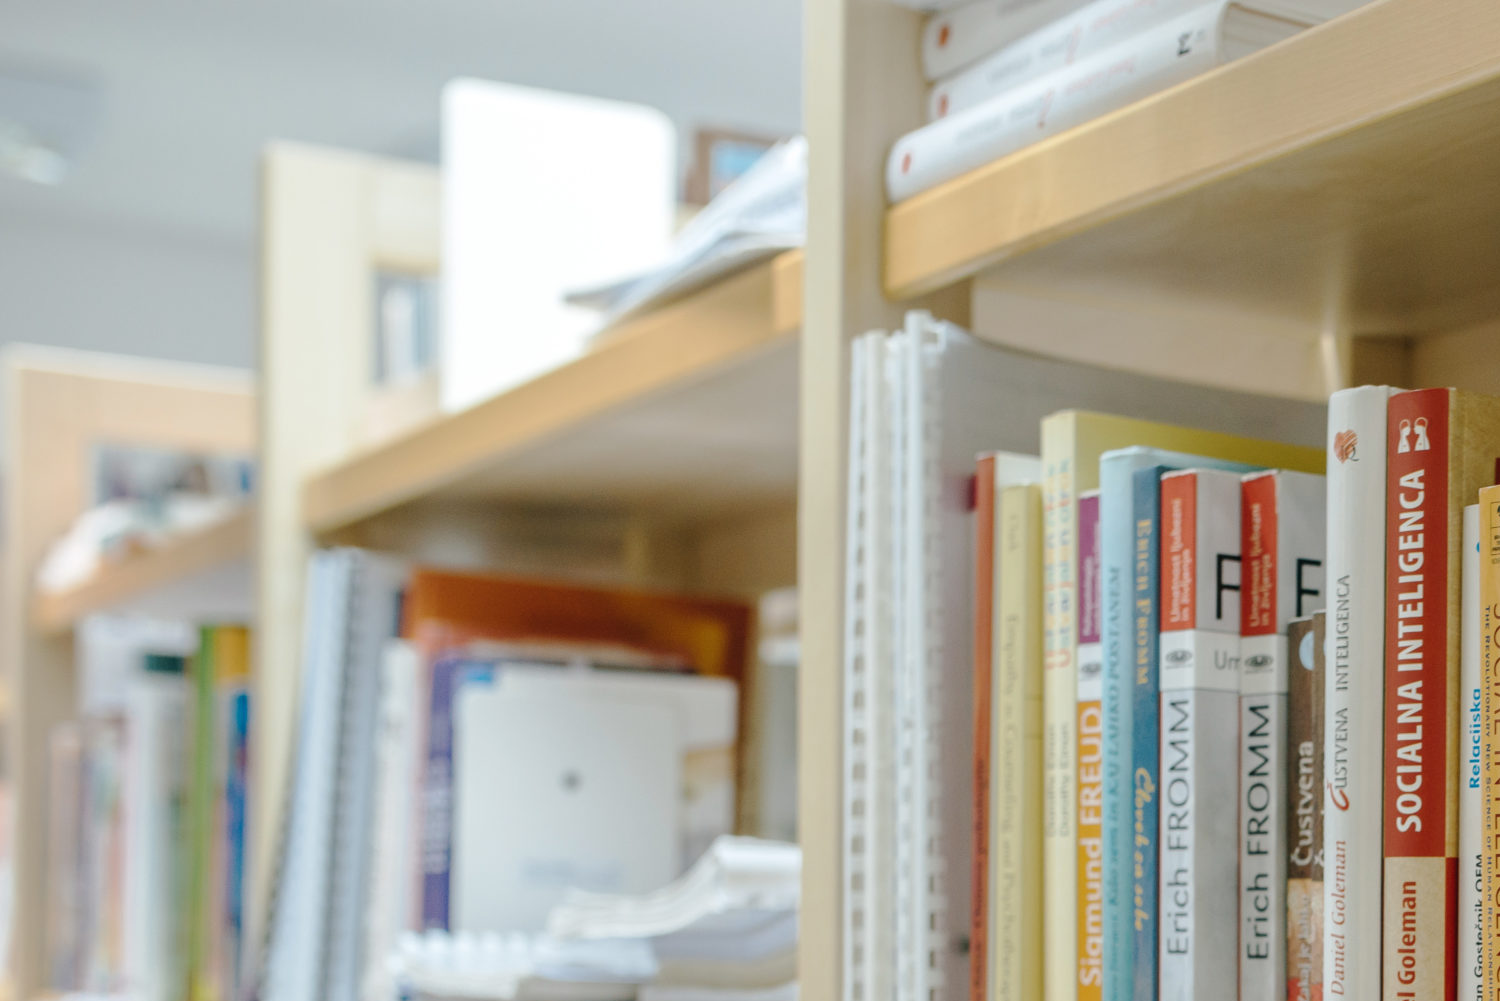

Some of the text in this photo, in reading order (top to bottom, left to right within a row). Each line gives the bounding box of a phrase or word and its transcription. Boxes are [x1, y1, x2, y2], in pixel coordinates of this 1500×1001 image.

[1335, 574, 1351, 692] INTELIGENCA
[1395, 469, 1426, 833] SOCIALNA INTELIGENCA
[1078, 706, 1102, 826] FREUD
[1165, 698, 1190, 956] Erich FROMM
[1246, 703, 1271, 960] Erich FROMM
[1290, 741, 1315, 867] Čustvena
[1330, 839, 1347, 997] Daniel Goleman
[1397, 880, 1418, 986] Goleman
